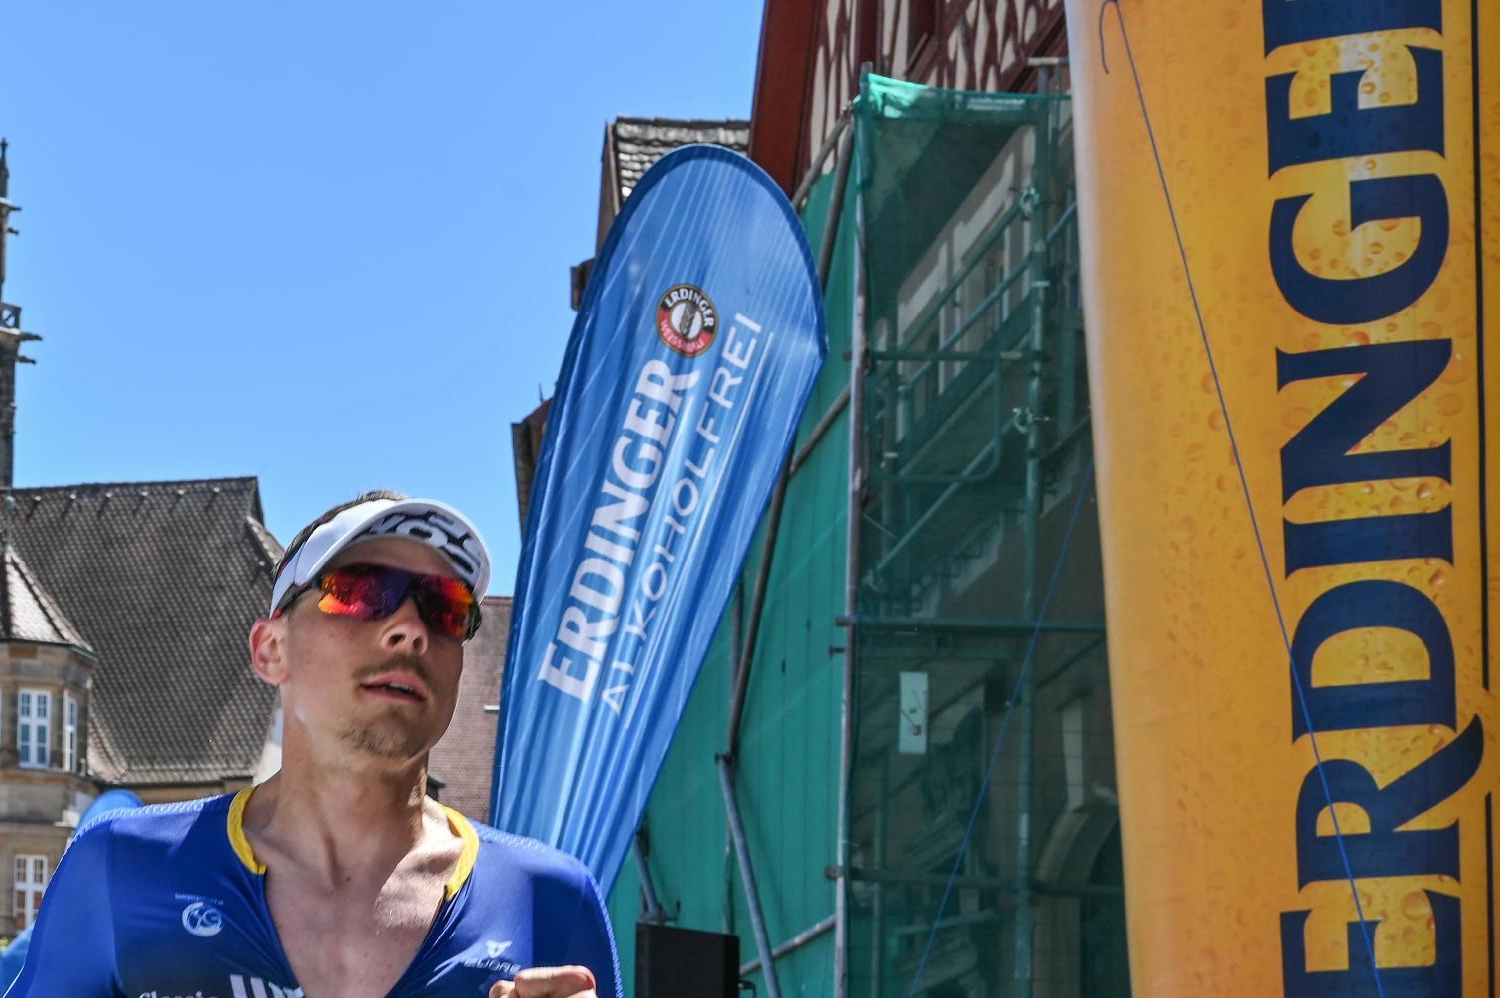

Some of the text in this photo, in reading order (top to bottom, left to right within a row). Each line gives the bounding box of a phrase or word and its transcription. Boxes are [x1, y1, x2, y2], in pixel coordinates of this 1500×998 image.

[664, 288, 715, 327] ERDINGER
[537, 358, 700, 703] ERDINGER
[601, 312, 762, 718] ALKOHOLFREI
